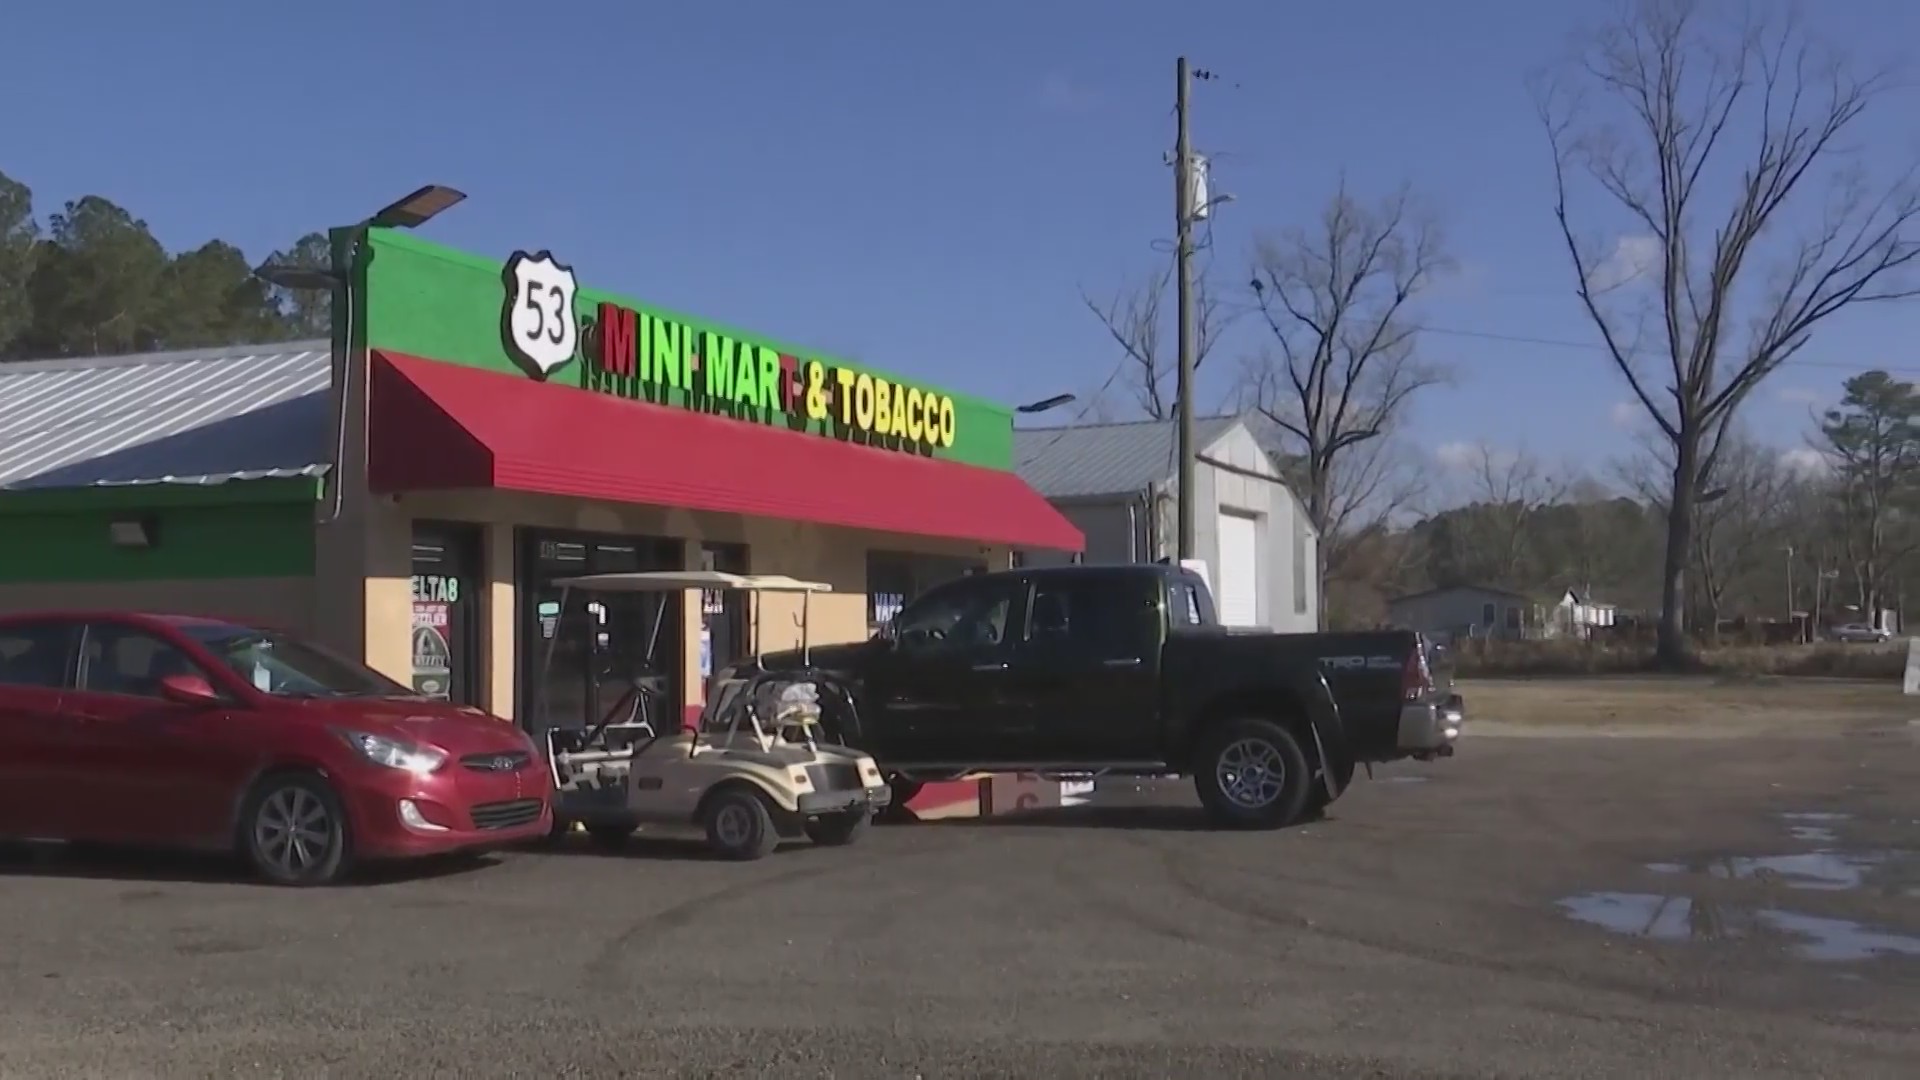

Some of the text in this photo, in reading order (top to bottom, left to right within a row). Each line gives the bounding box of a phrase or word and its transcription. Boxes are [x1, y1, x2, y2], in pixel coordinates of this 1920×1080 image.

[525, 281, 565, 345] 53
[705, 331, 799, 413] MART
[806, 360, 828, 420] &
[837, 367, 956, 448] TOBACCO
